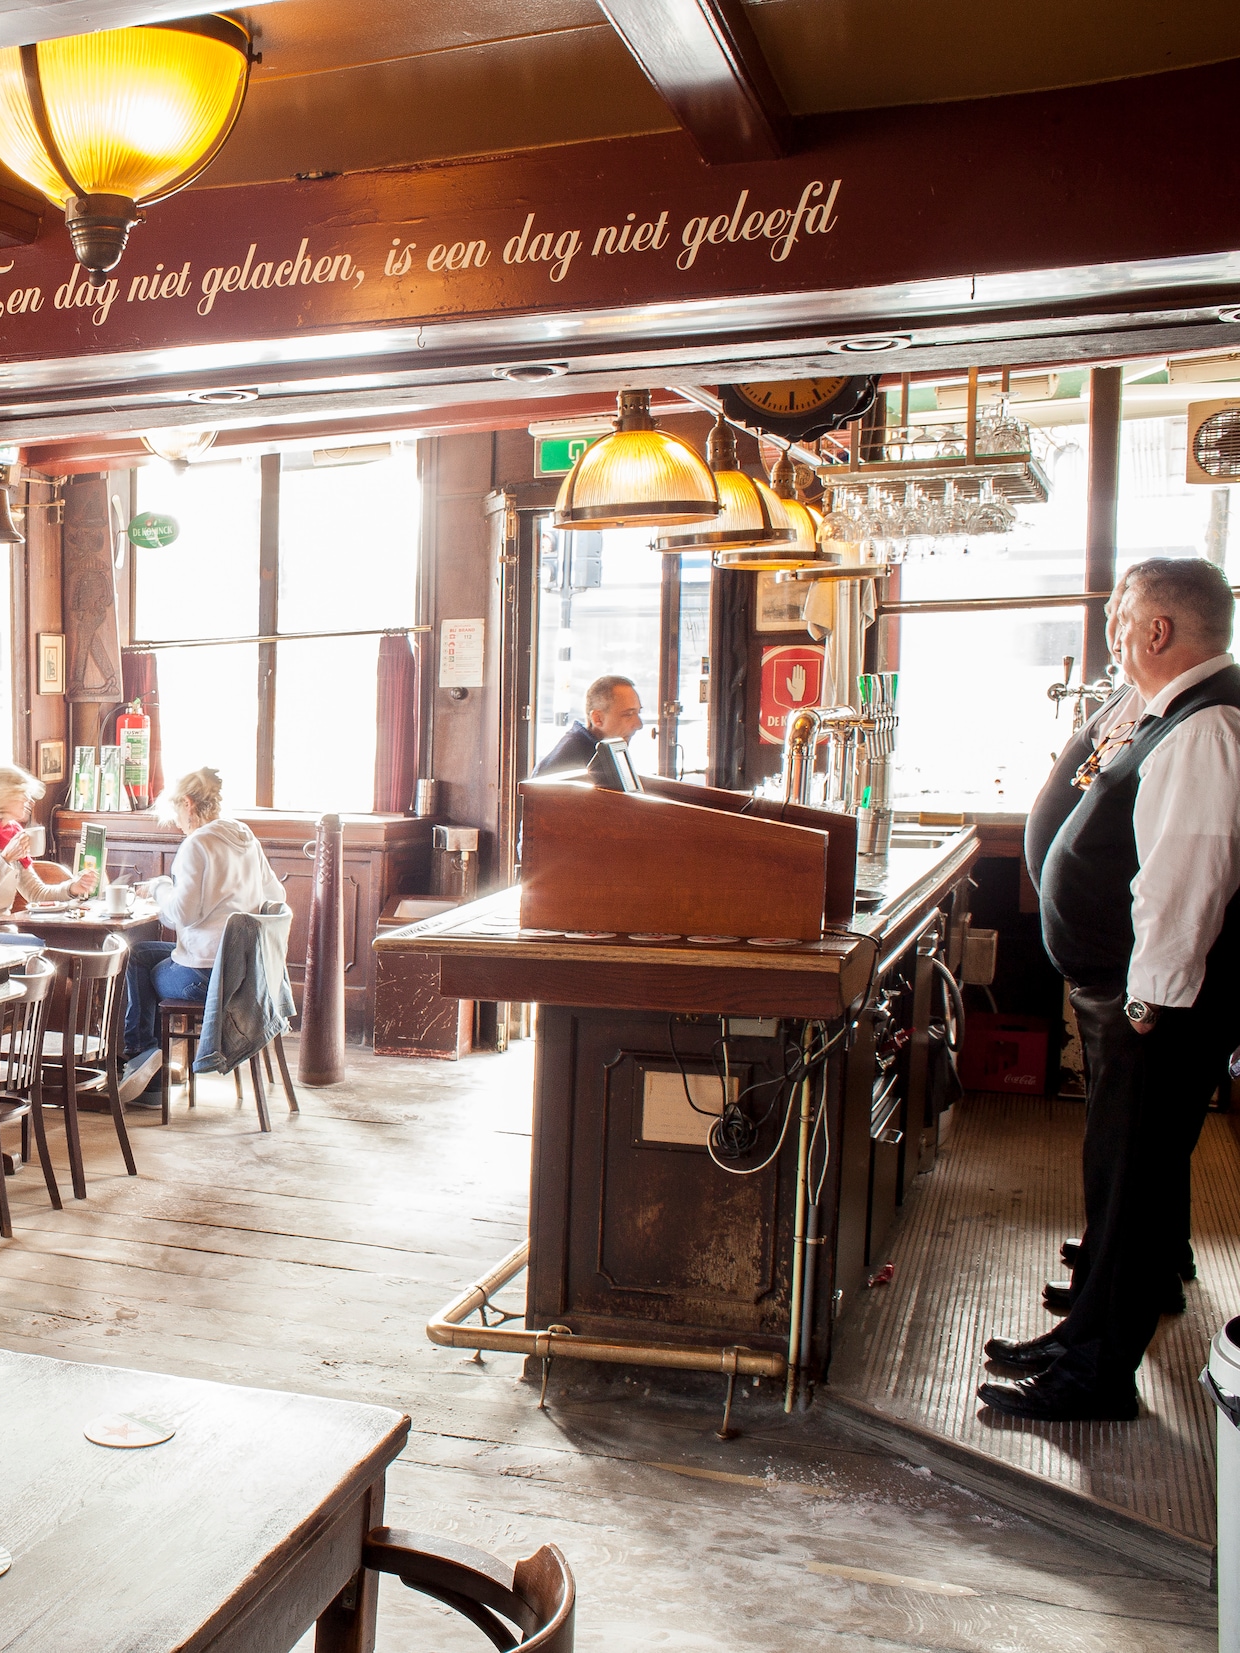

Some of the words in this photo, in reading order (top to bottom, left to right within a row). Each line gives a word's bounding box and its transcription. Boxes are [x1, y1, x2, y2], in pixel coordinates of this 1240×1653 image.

[54, 275, 121, 326] dag
[127, 260, 191, 306] niet
[196, 237, 366, 317] gelachen,
[383, 236, 416, 277] is
[426, 236, 492, 273] een
[502, 213, 582, 283] dag
[593, 210, 670, 255] niet
[675, 180, 843, 271] geleefd
[132, 528, 141, 536] DE
[768, 716, 779, 727] DE
